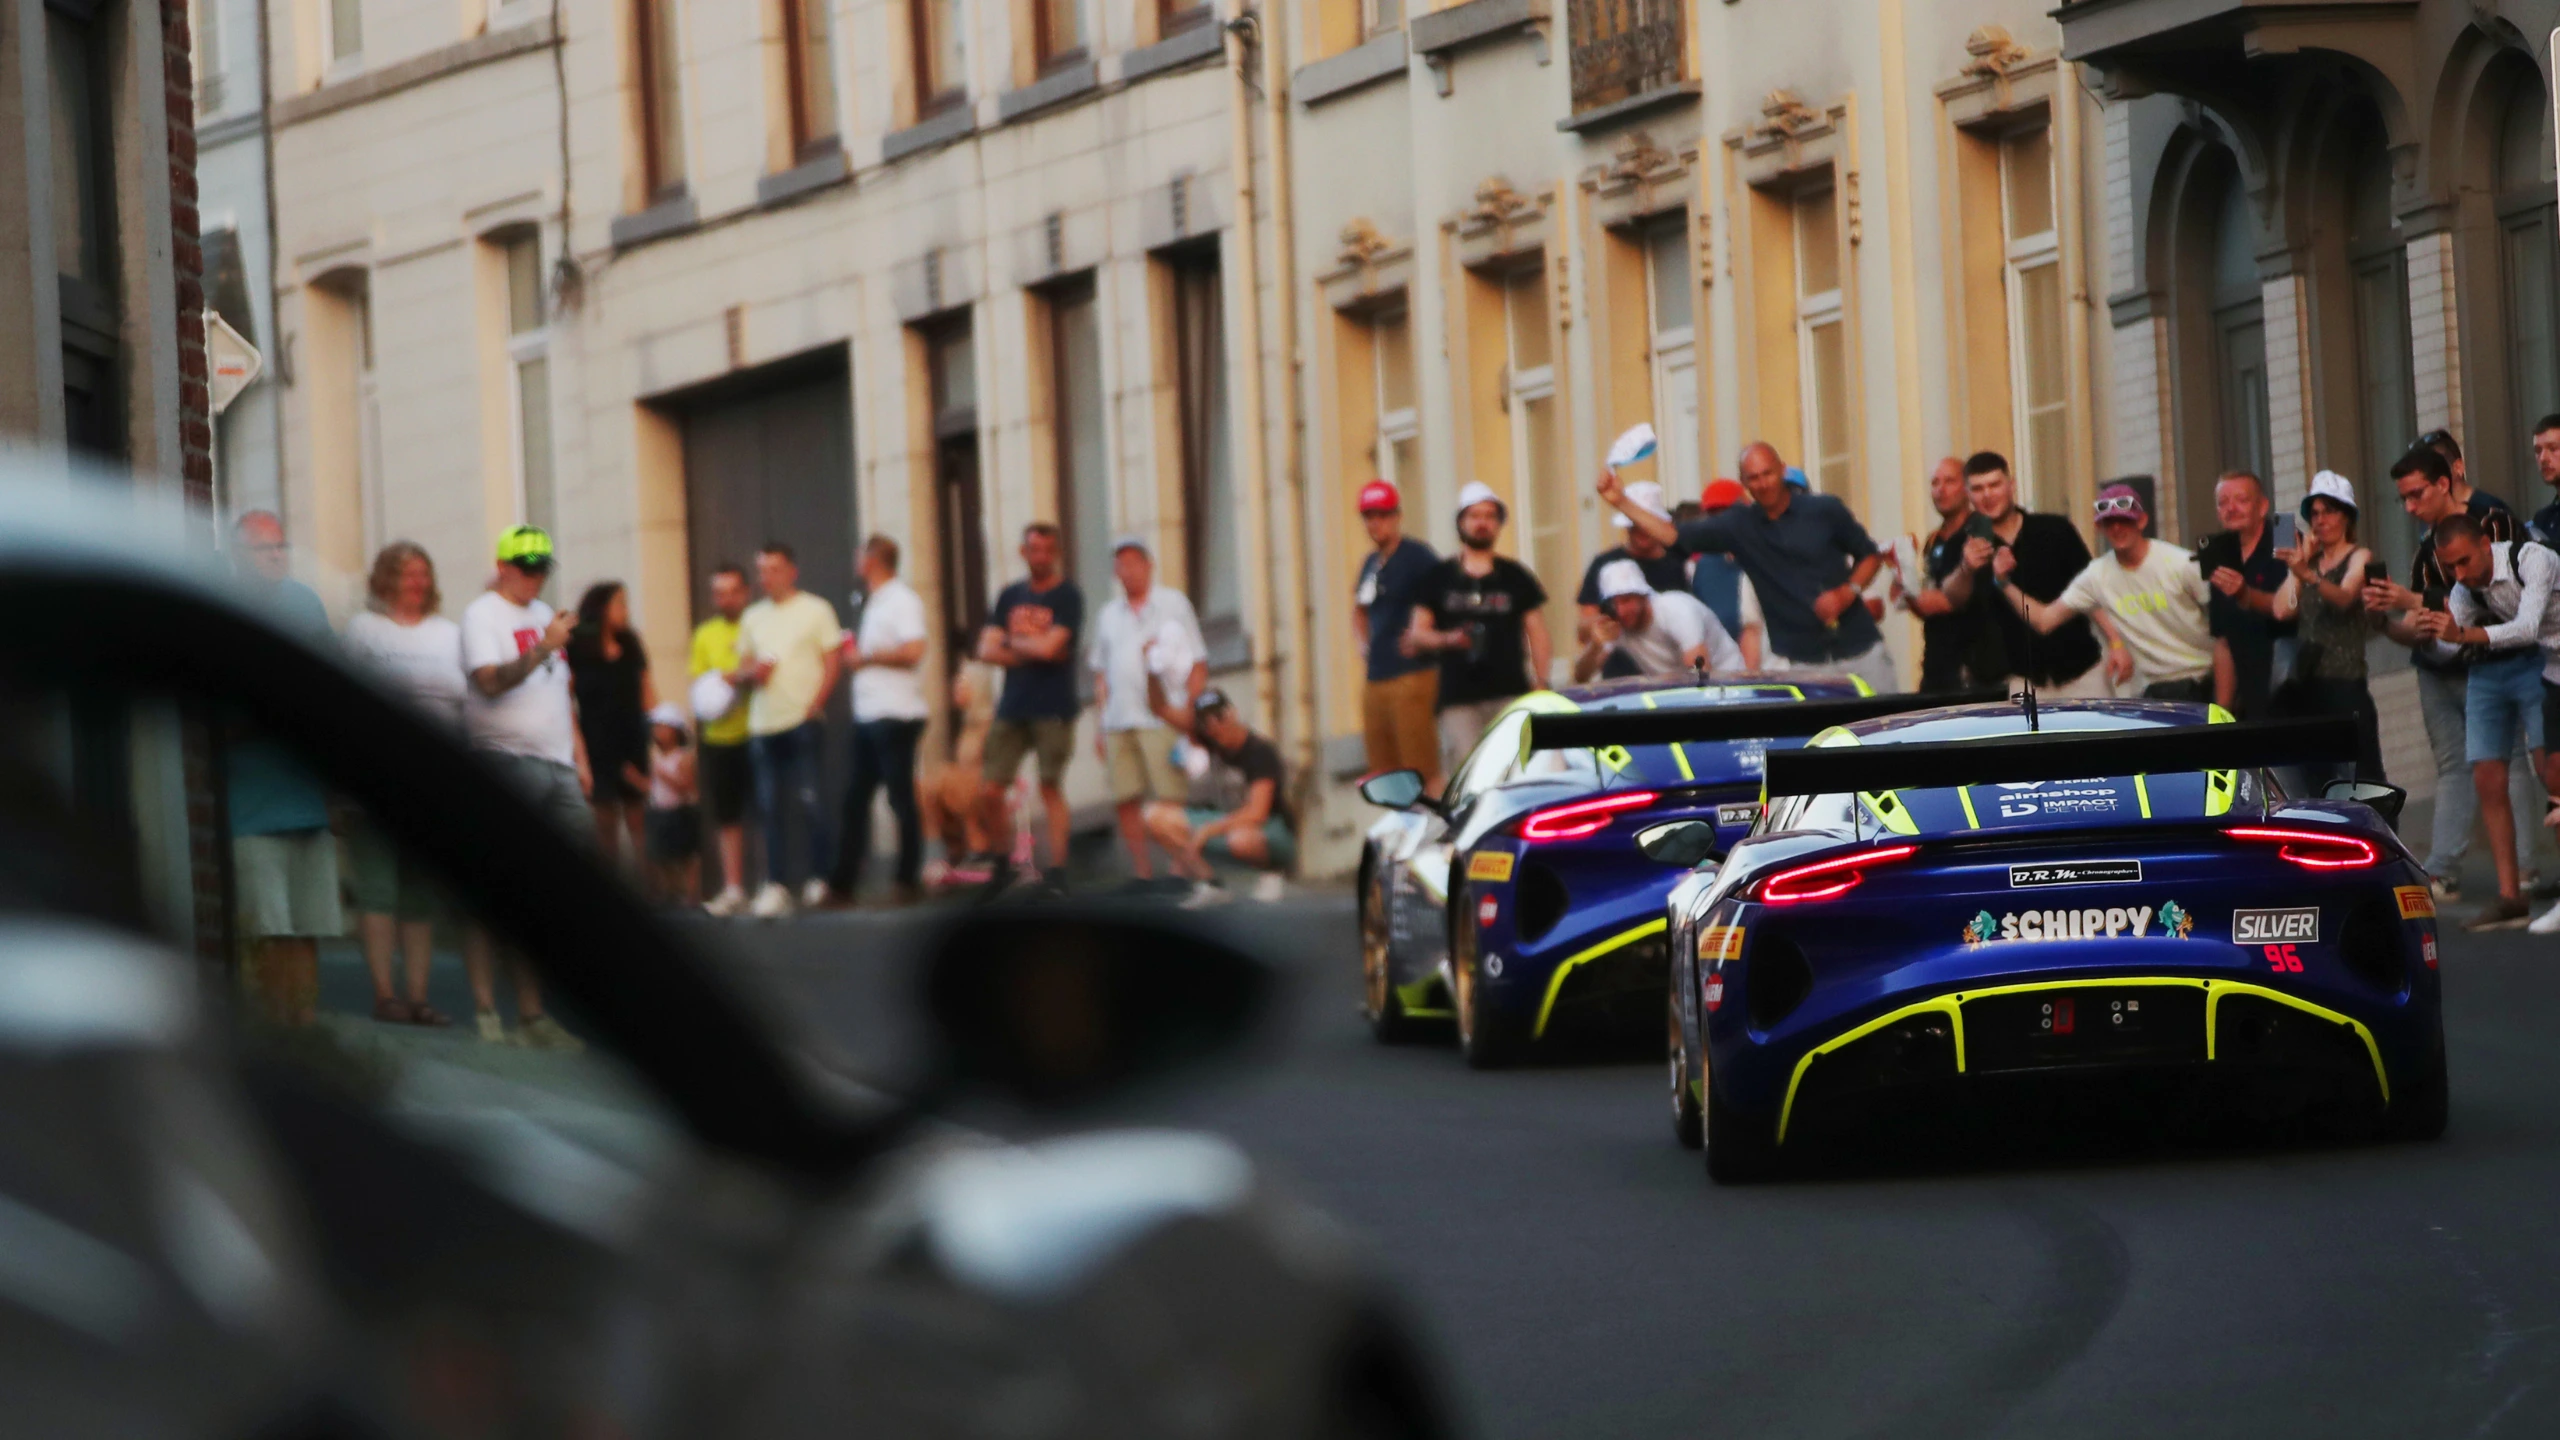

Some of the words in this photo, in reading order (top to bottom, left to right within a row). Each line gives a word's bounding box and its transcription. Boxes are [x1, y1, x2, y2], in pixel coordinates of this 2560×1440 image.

[2043, 799, 2118, 808] IMPACT
[2045, 804, 2119, 814] DETECT
[2001, 906, 2152, 942] $CHIPPY
[2238, 914, 2314, 938] SILVER
[2264, 944, 2304, 972] 96
